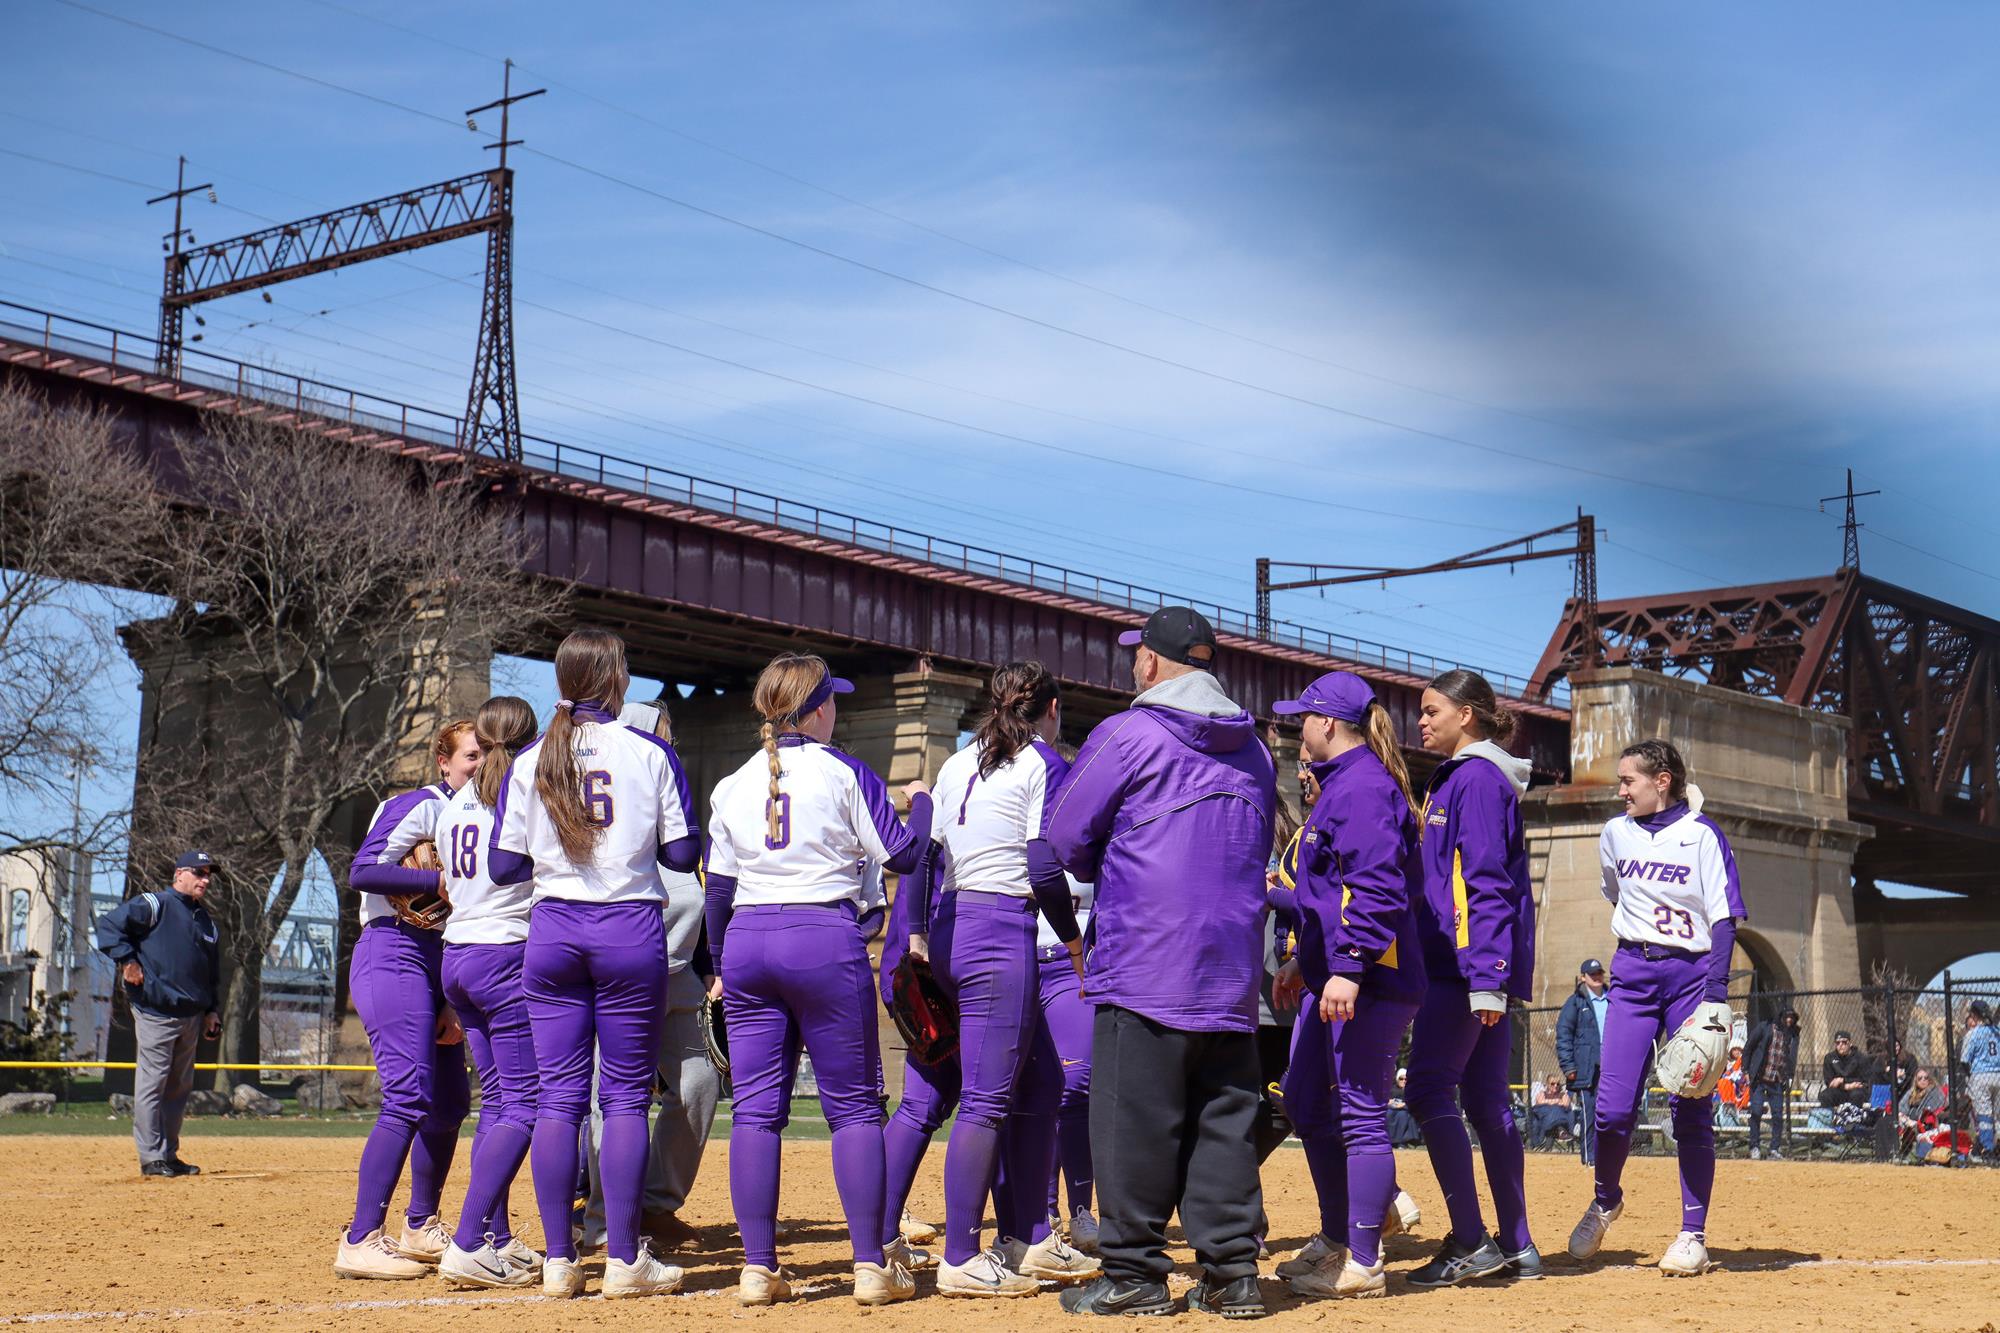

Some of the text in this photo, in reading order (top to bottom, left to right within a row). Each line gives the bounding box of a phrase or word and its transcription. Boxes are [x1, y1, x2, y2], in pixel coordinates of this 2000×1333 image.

[584, 770, 613, 828] 6
[451, 824, 479, 879] 18
[1654, 905, 1694, 939] 23
